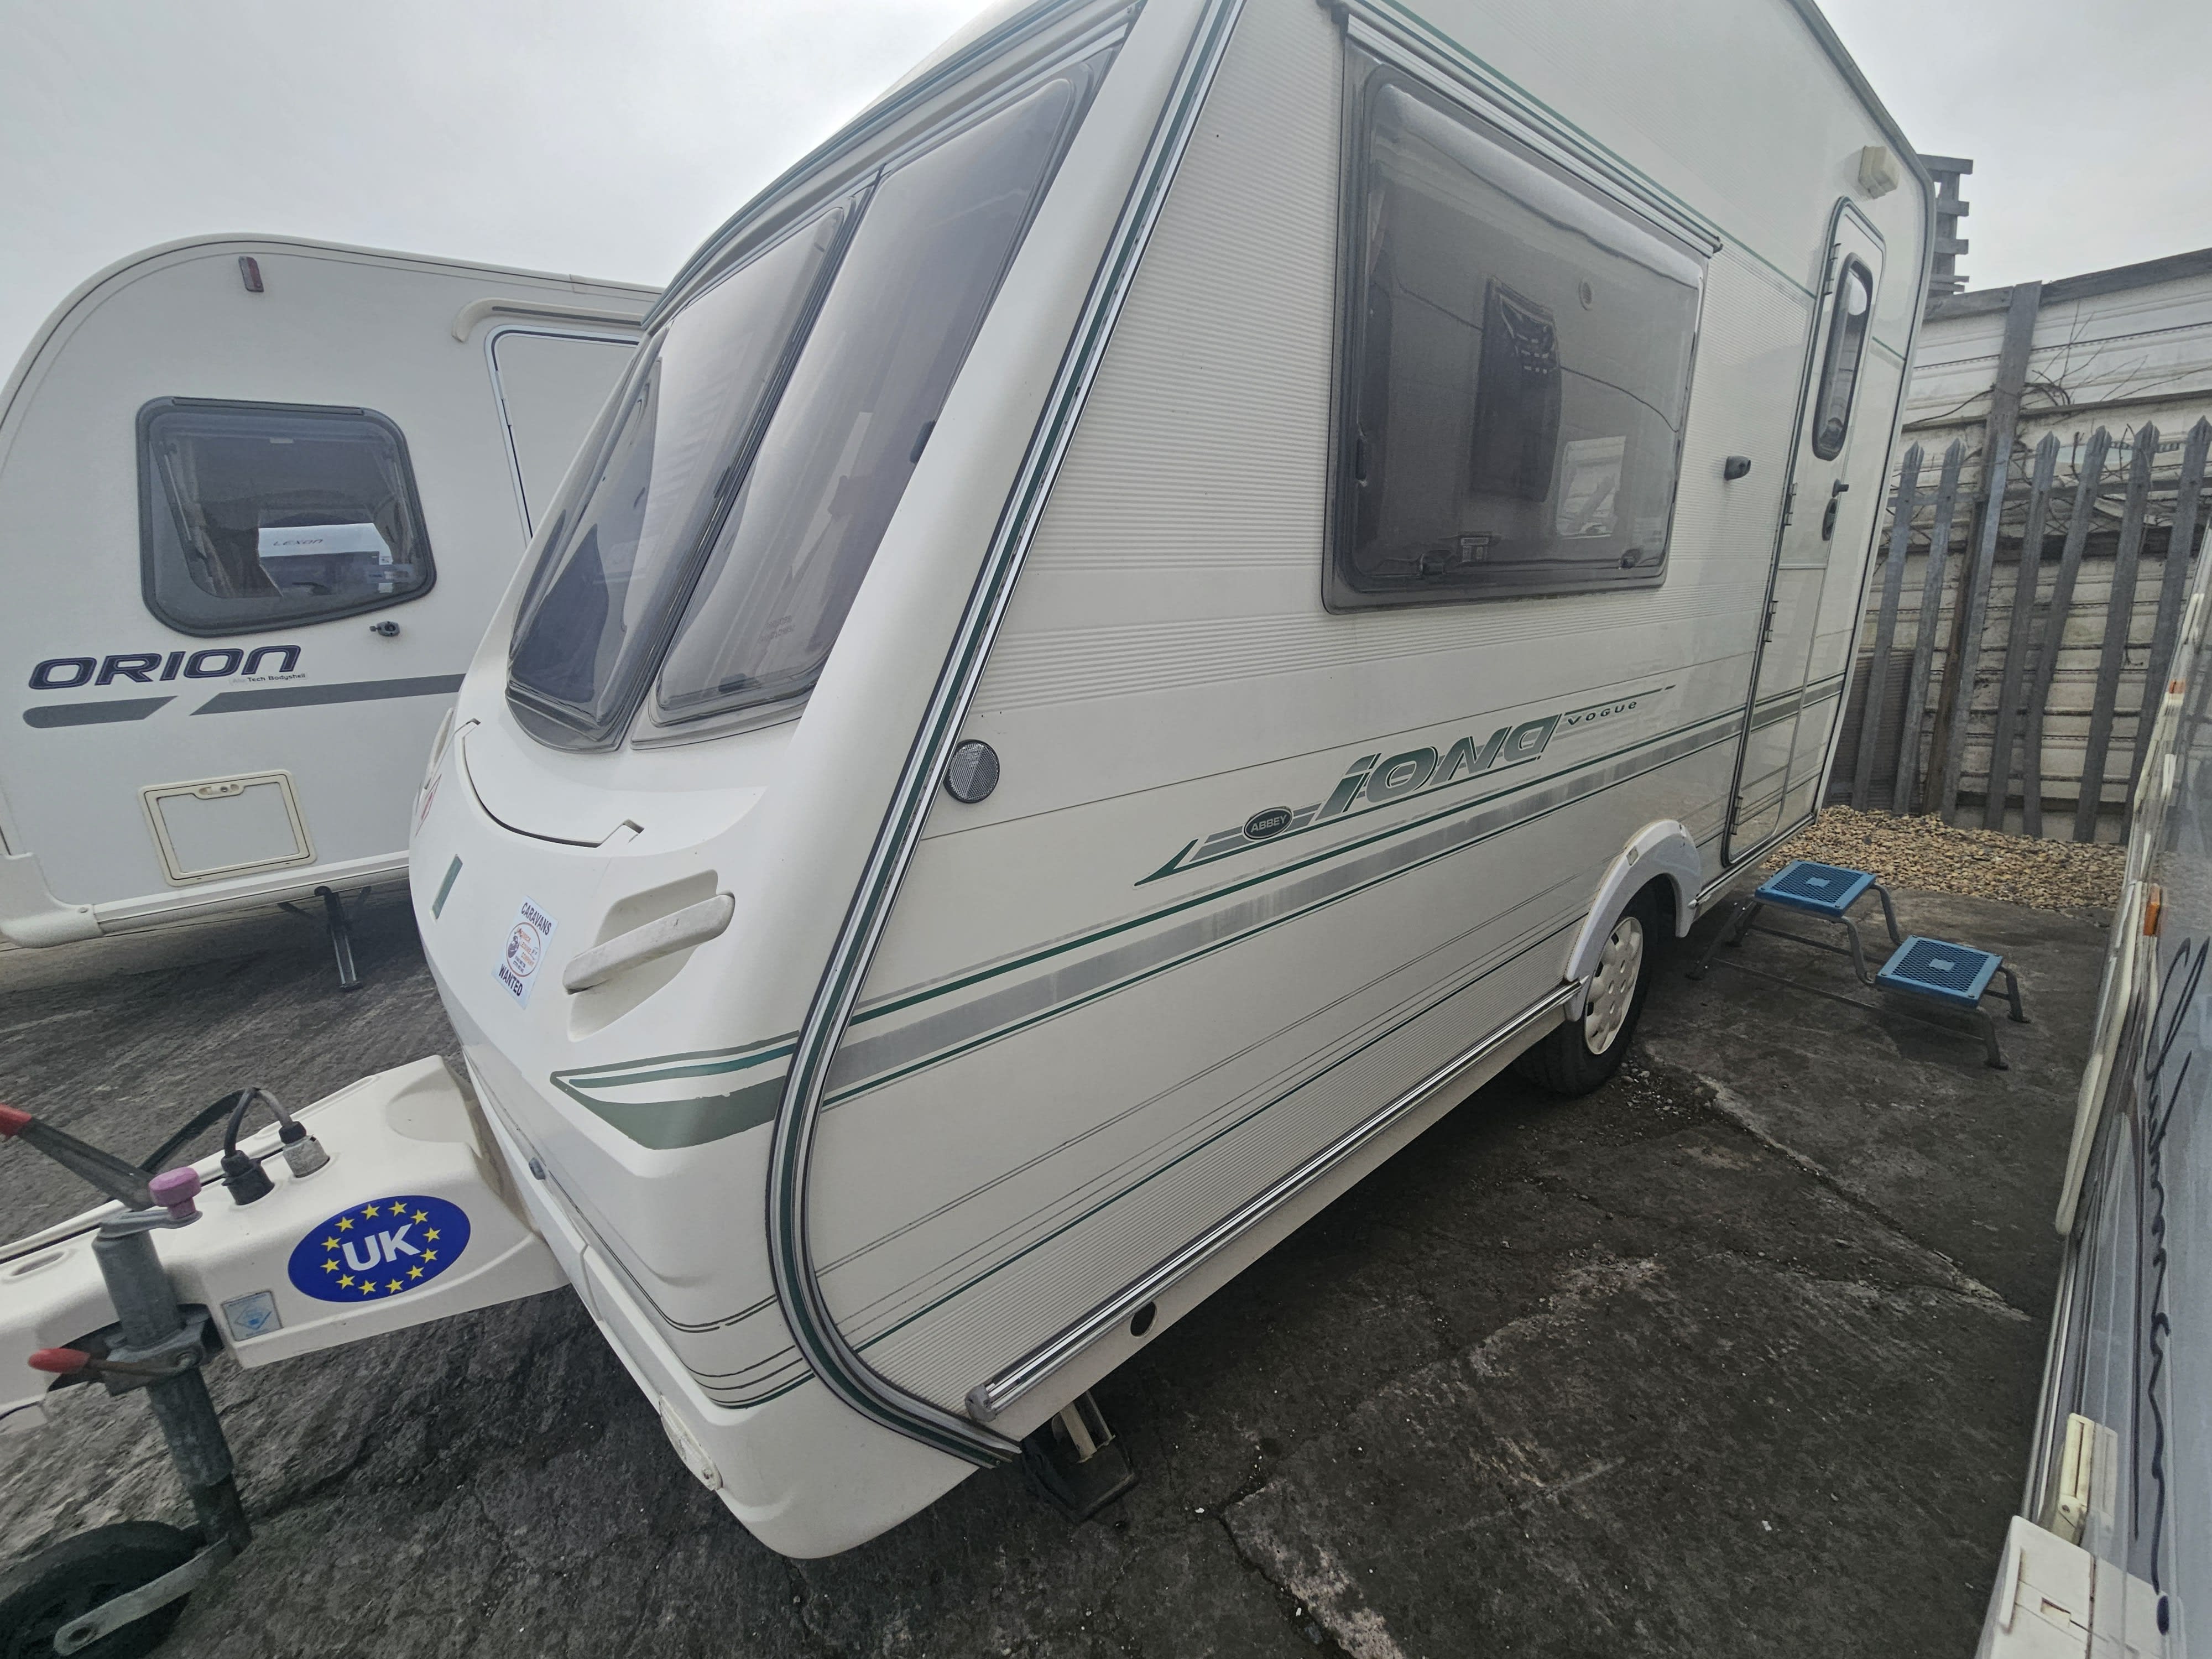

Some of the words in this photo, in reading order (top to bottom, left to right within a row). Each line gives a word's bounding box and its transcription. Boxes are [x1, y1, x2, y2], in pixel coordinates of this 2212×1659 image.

[28, 645, 301, 690] ORION
[1250, 814, 1287, 833] ABBEY
[521, 902, 552, 936] CARAVANS
[498, 963, 523, 997] WANTED
[342, 1223, 421, 1271] UK
